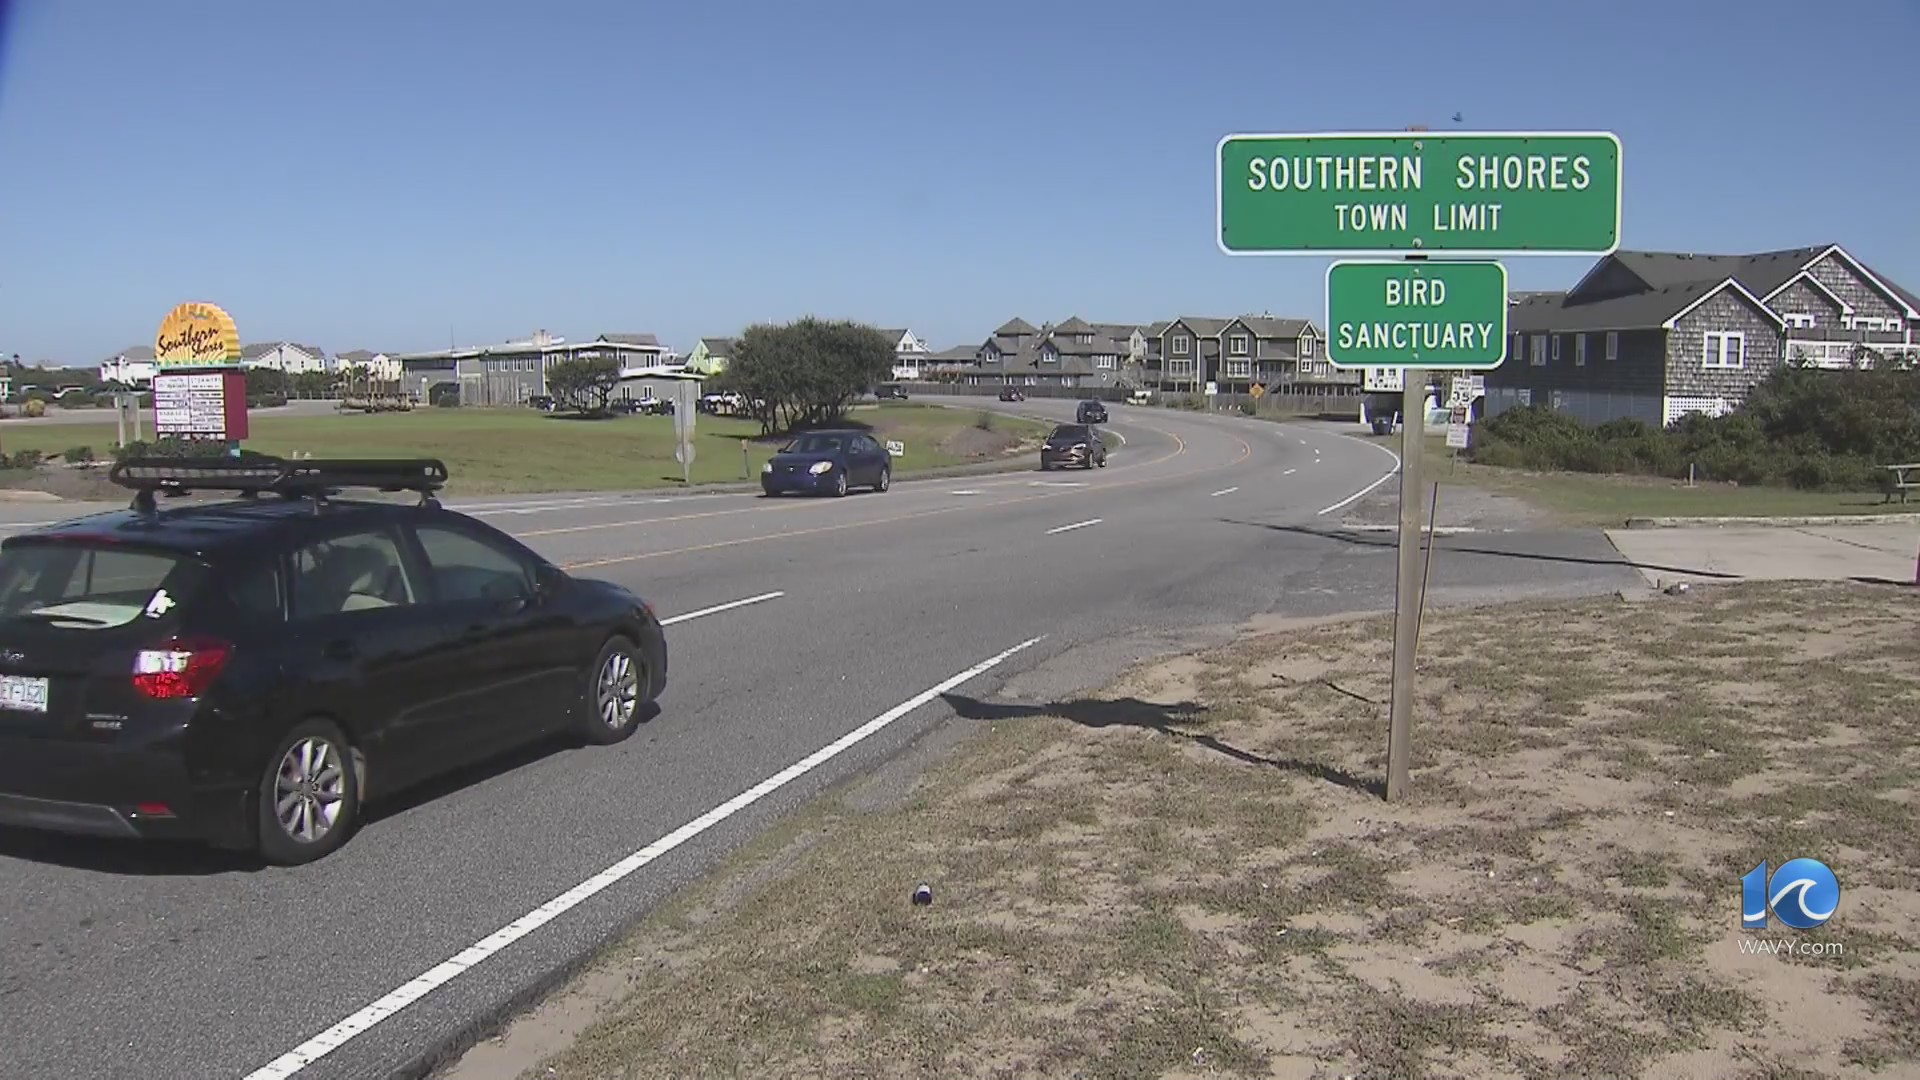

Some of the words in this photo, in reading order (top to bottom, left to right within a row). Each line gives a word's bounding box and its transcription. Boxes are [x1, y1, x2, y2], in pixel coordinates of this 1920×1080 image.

[1247, 155, 1423, 191] SOUTHERN
[1455, 154, 1591, 190] SHORES
[1335, 203, 1408, 232] TOWN
[1433, 203, 1503, 231] LIMIT
[1385, 278, 1447, 307] BIRD
[158, 323, 219, 357] Southern
[191, 341, 224, 358] Shores
[1338, 322, 1494, 350] SANCTUARY
[1452, 391, 1470, 403] 35
